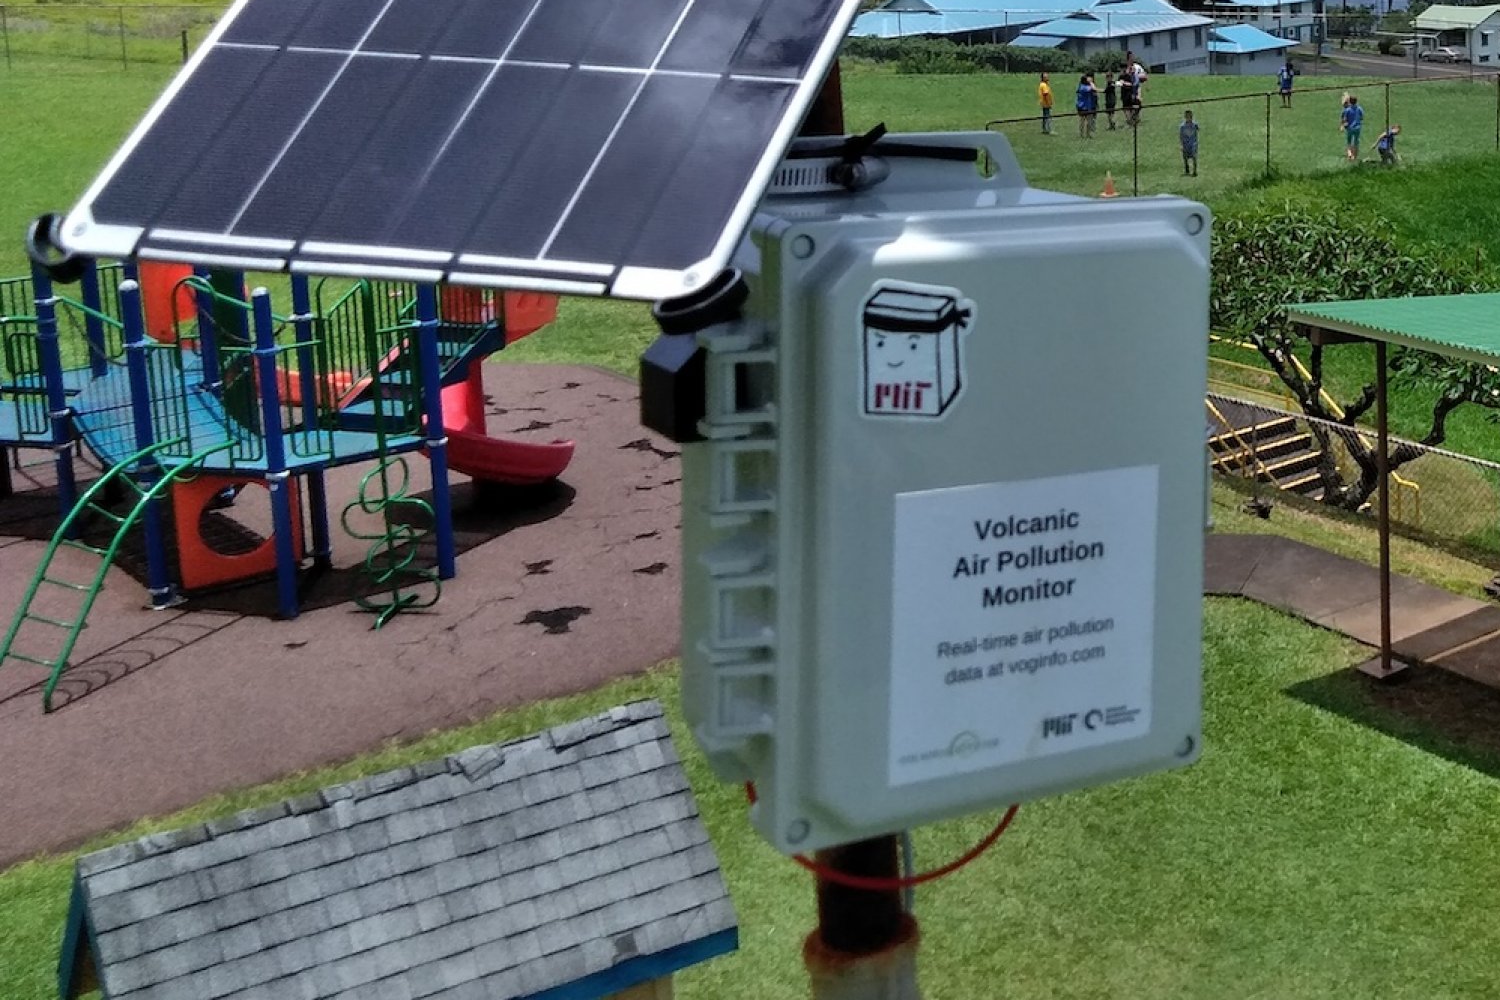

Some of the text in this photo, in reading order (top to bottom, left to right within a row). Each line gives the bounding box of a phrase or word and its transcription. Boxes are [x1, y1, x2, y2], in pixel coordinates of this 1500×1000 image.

[974, 508, 1080, 540] Volcanic
[953, 540, 1104, 578] Air Pollution
[982, 578, 1076, 608] Monitor
[937, 617, 1115, 658] Real-time air pollution
[944, 645, 1106, 685] data at voginfo.com
